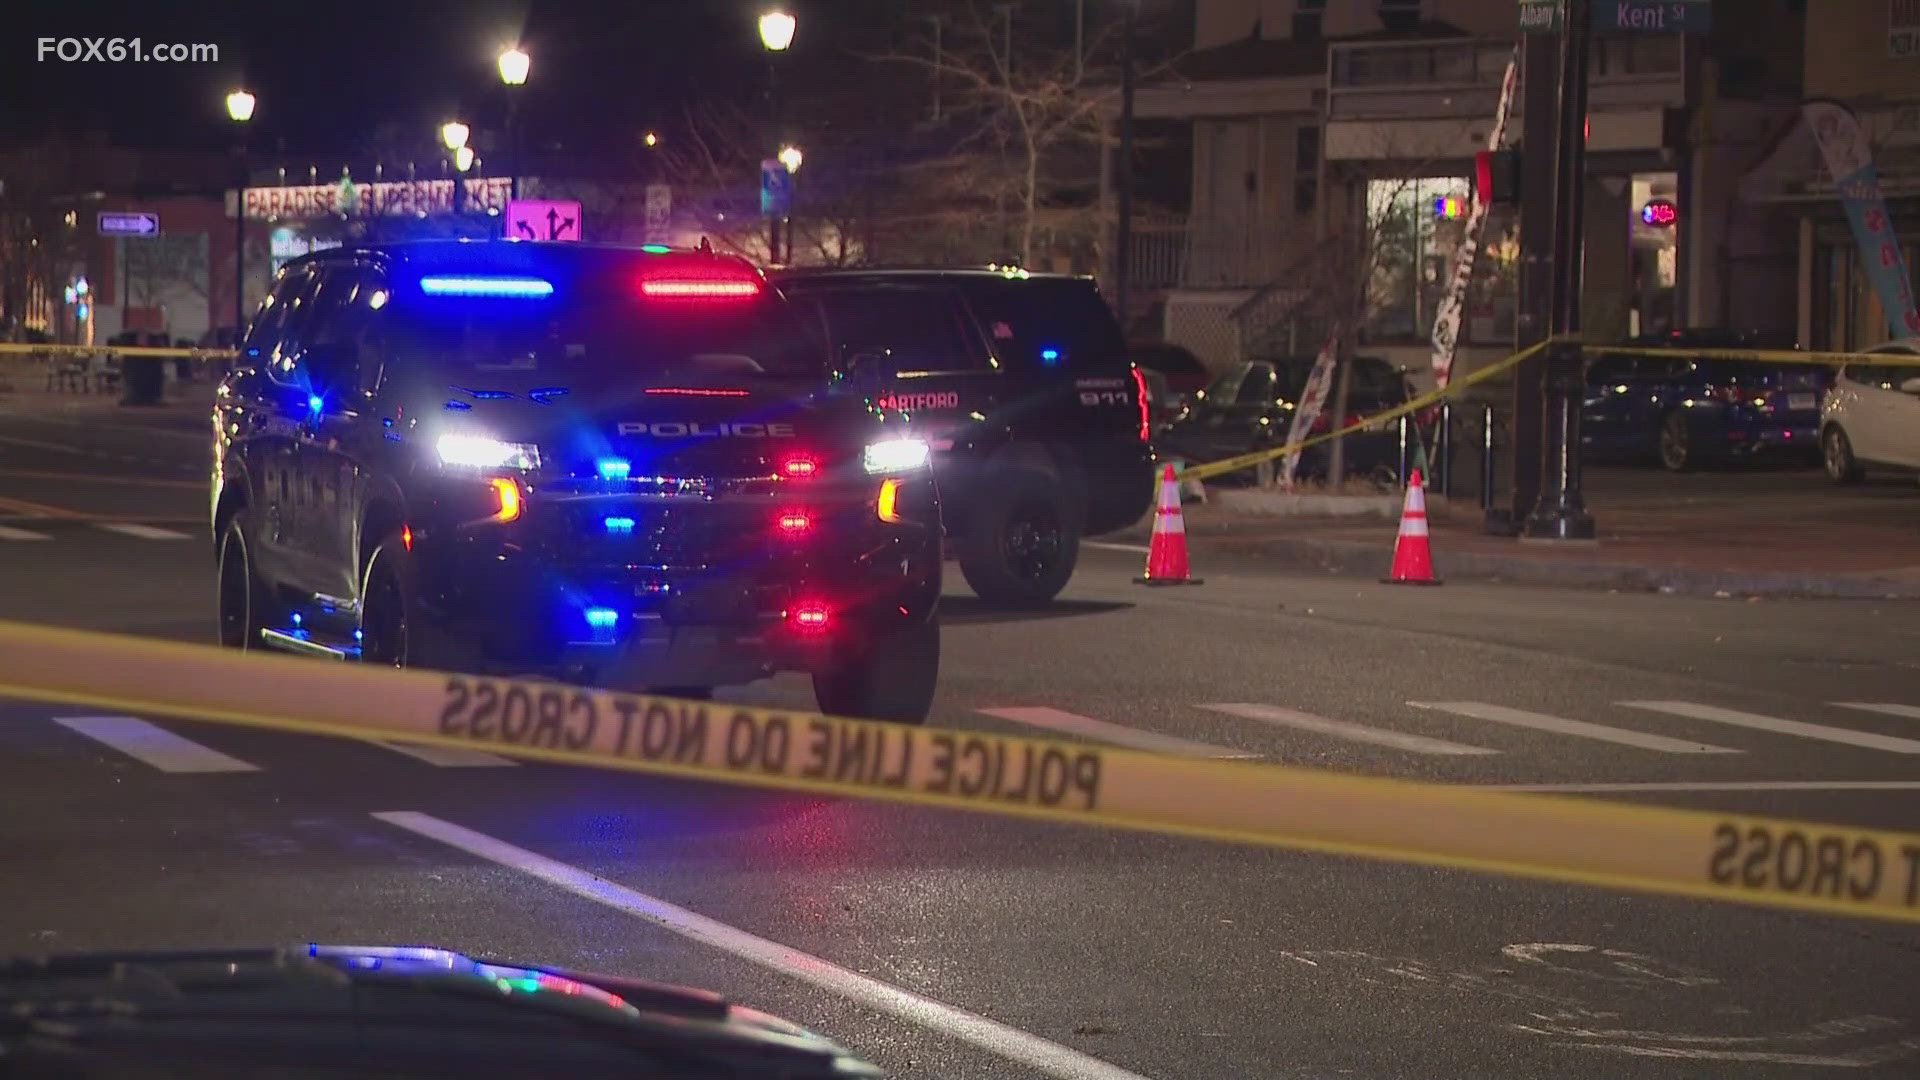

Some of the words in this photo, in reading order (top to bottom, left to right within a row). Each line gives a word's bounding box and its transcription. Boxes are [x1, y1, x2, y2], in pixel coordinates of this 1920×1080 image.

[1520, 3, 1554, 28] Albany
[1617, 3, 1664, 28] Kent
[247, 189, 337, 216] PARADISE
[360, 181, 513, 215] SUPERMKET
[879, 391, 958, 408] ARTFORD
[1080, 391, 1129, 405] 911
[617, 422, 796, 437] POLICE
